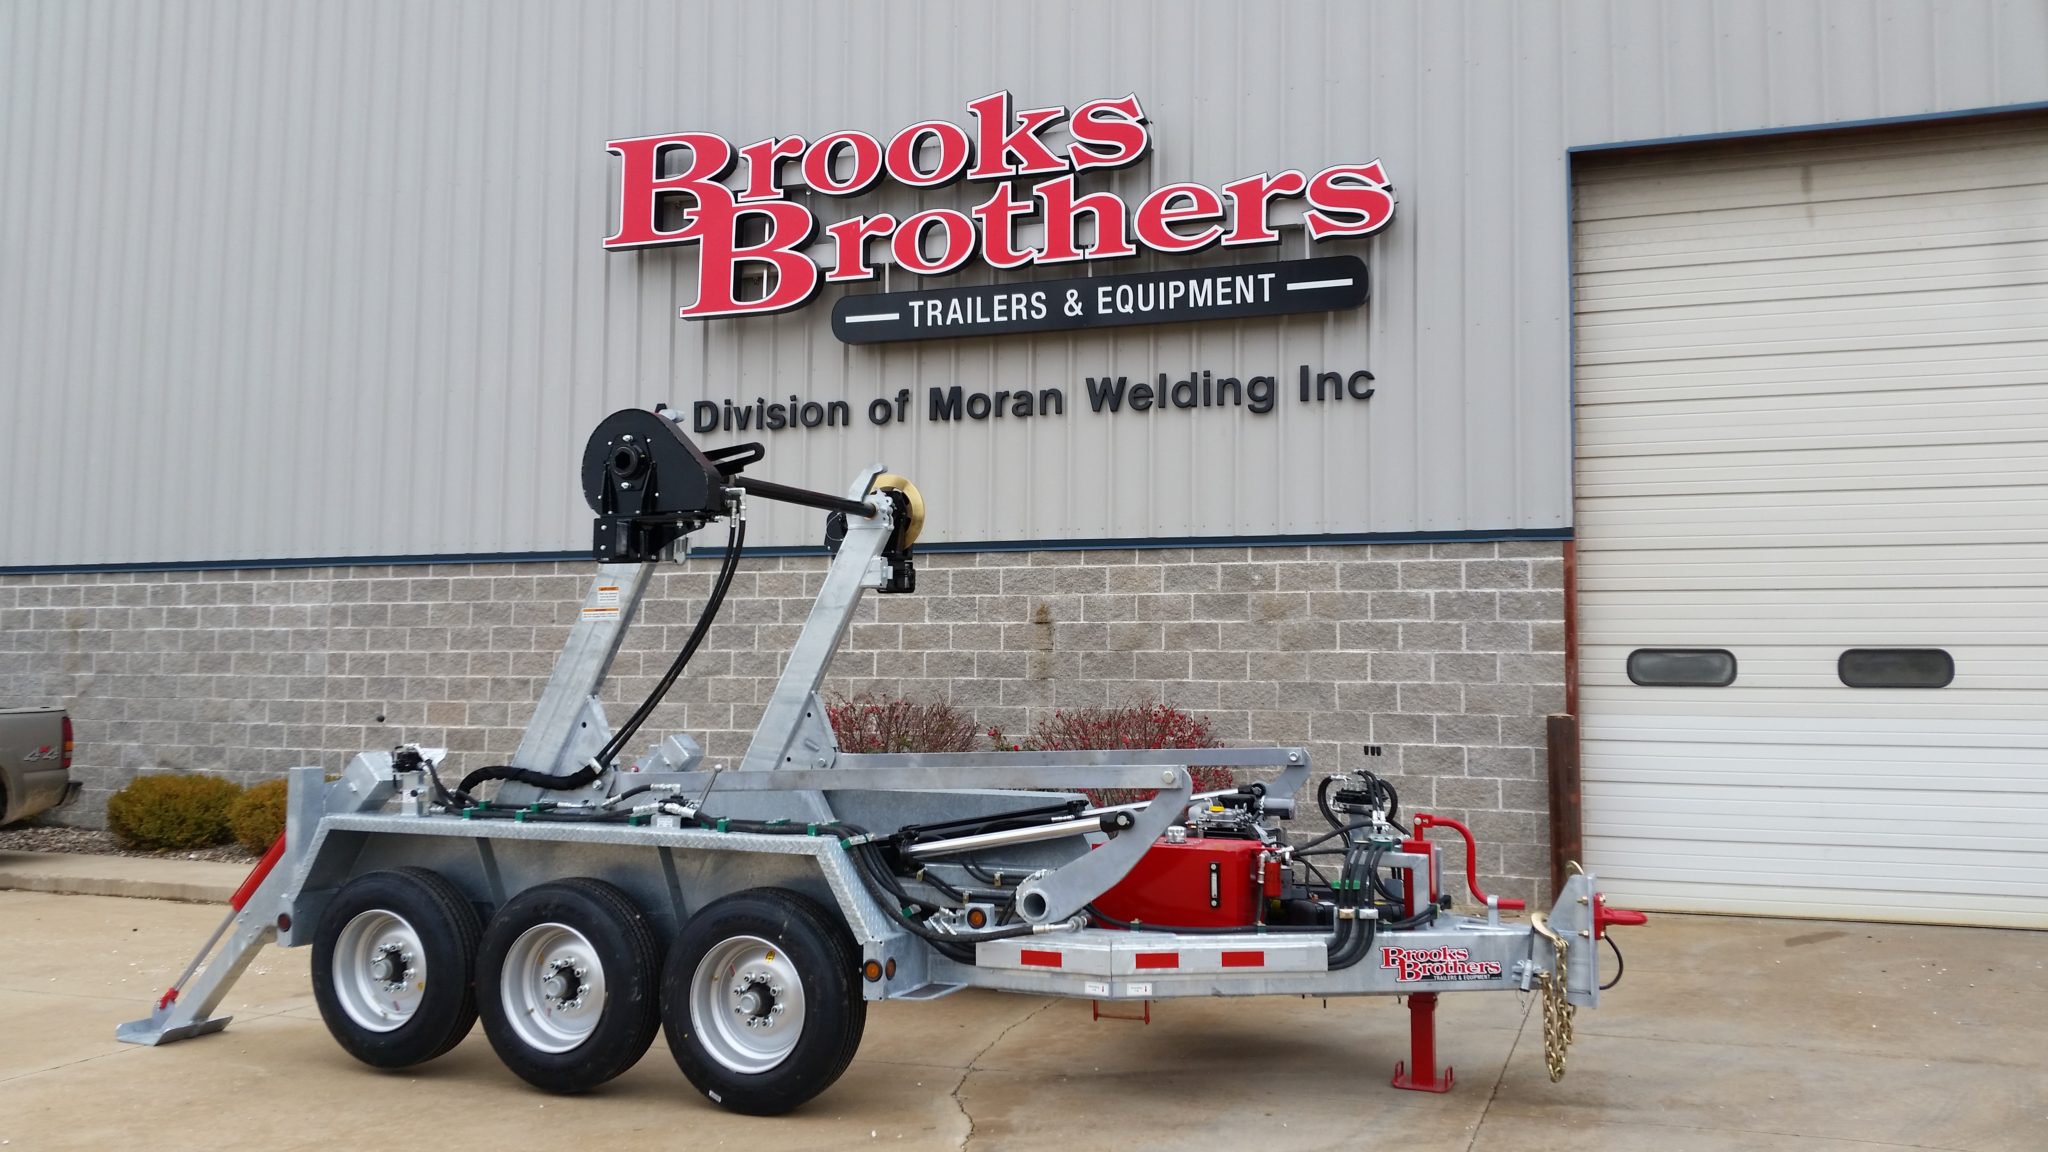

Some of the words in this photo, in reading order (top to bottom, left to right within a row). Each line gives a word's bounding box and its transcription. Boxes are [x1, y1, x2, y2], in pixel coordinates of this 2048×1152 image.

[602, 89, 1151, 250] Brooks
[679, 157, 1396, 318] Brothers
[908, 291, 1047, 328] TRAILERS
[1063, 289, 1084, 317] &
[1097, 273, 1276, 315] EQUIPMENT
[693, 395, 850, 433] Division
[868, 388, 910, 425] of
[928, 385, 1063, 421] Moran
[1085, 370, 1276, 414] Welding
[1299, 364, 1376, 402] Inc
[1380, 945, 1469, 968] Brooks
[1396, 959, 1501, 982] Brothers
